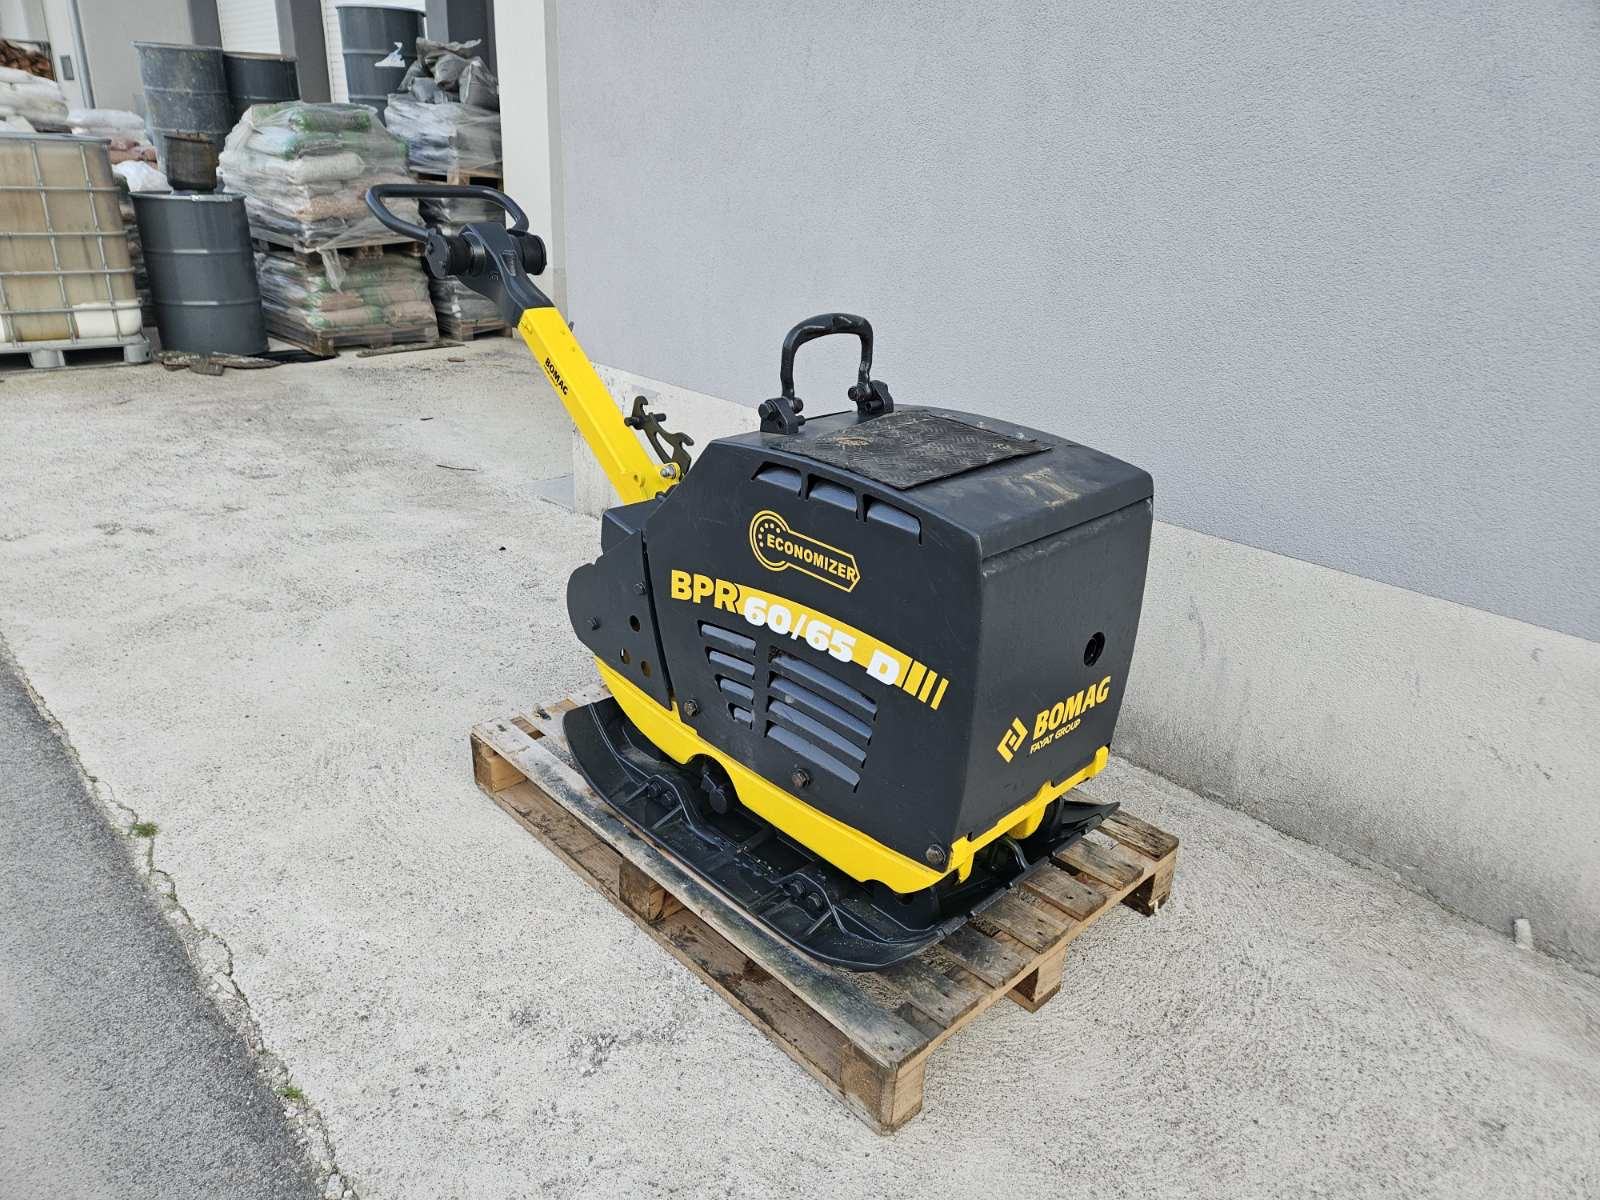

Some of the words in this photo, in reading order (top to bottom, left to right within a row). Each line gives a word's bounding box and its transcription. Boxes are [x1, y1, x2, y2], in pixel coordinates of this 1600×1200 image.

[545, 357, 569, 396] BOMAG
[766, 533, 856, 583] ECONOMIZER
[866, 650, 901, 686] D
[1033, 676, 1111, 741] BOMAG
[1030, 733, 1055, 754] FAYAT
[1055, 718, 1081, 739] GROUP
